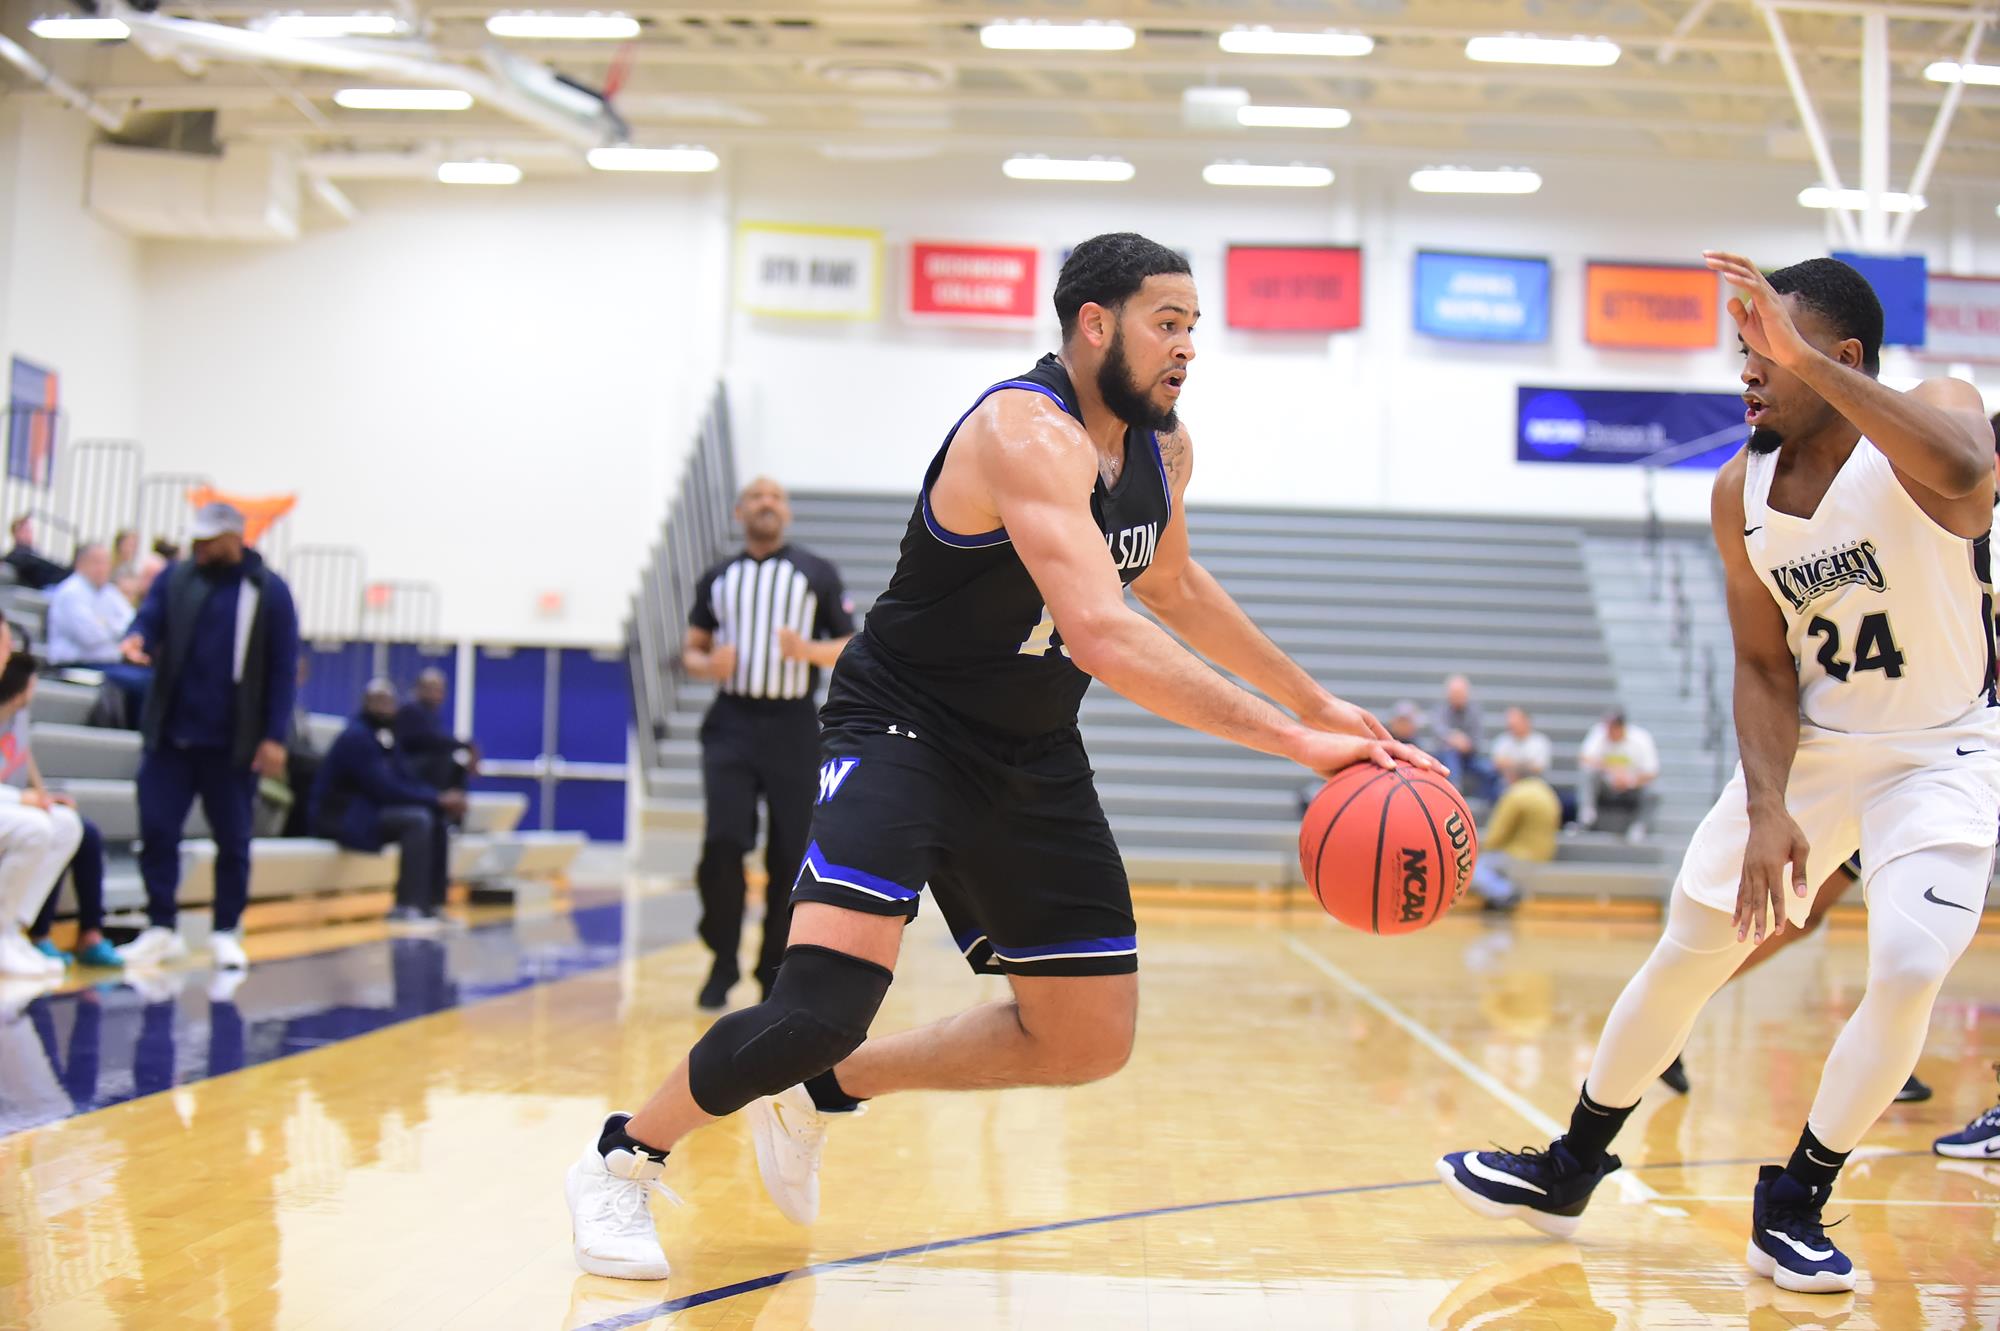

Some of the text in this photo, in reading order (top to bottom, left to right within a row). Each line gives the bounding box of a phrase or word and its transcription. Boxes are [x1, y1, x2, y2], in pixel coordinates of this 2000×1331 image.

[1770, 540, 1886, 613] KNIGHTS
[1788, 540, 1857, 565] GENESEO
[1807, 610, 1906, 683] 24
[817, 757, 861, 805] W
[1399, 847, 1428, 923] NCAA
